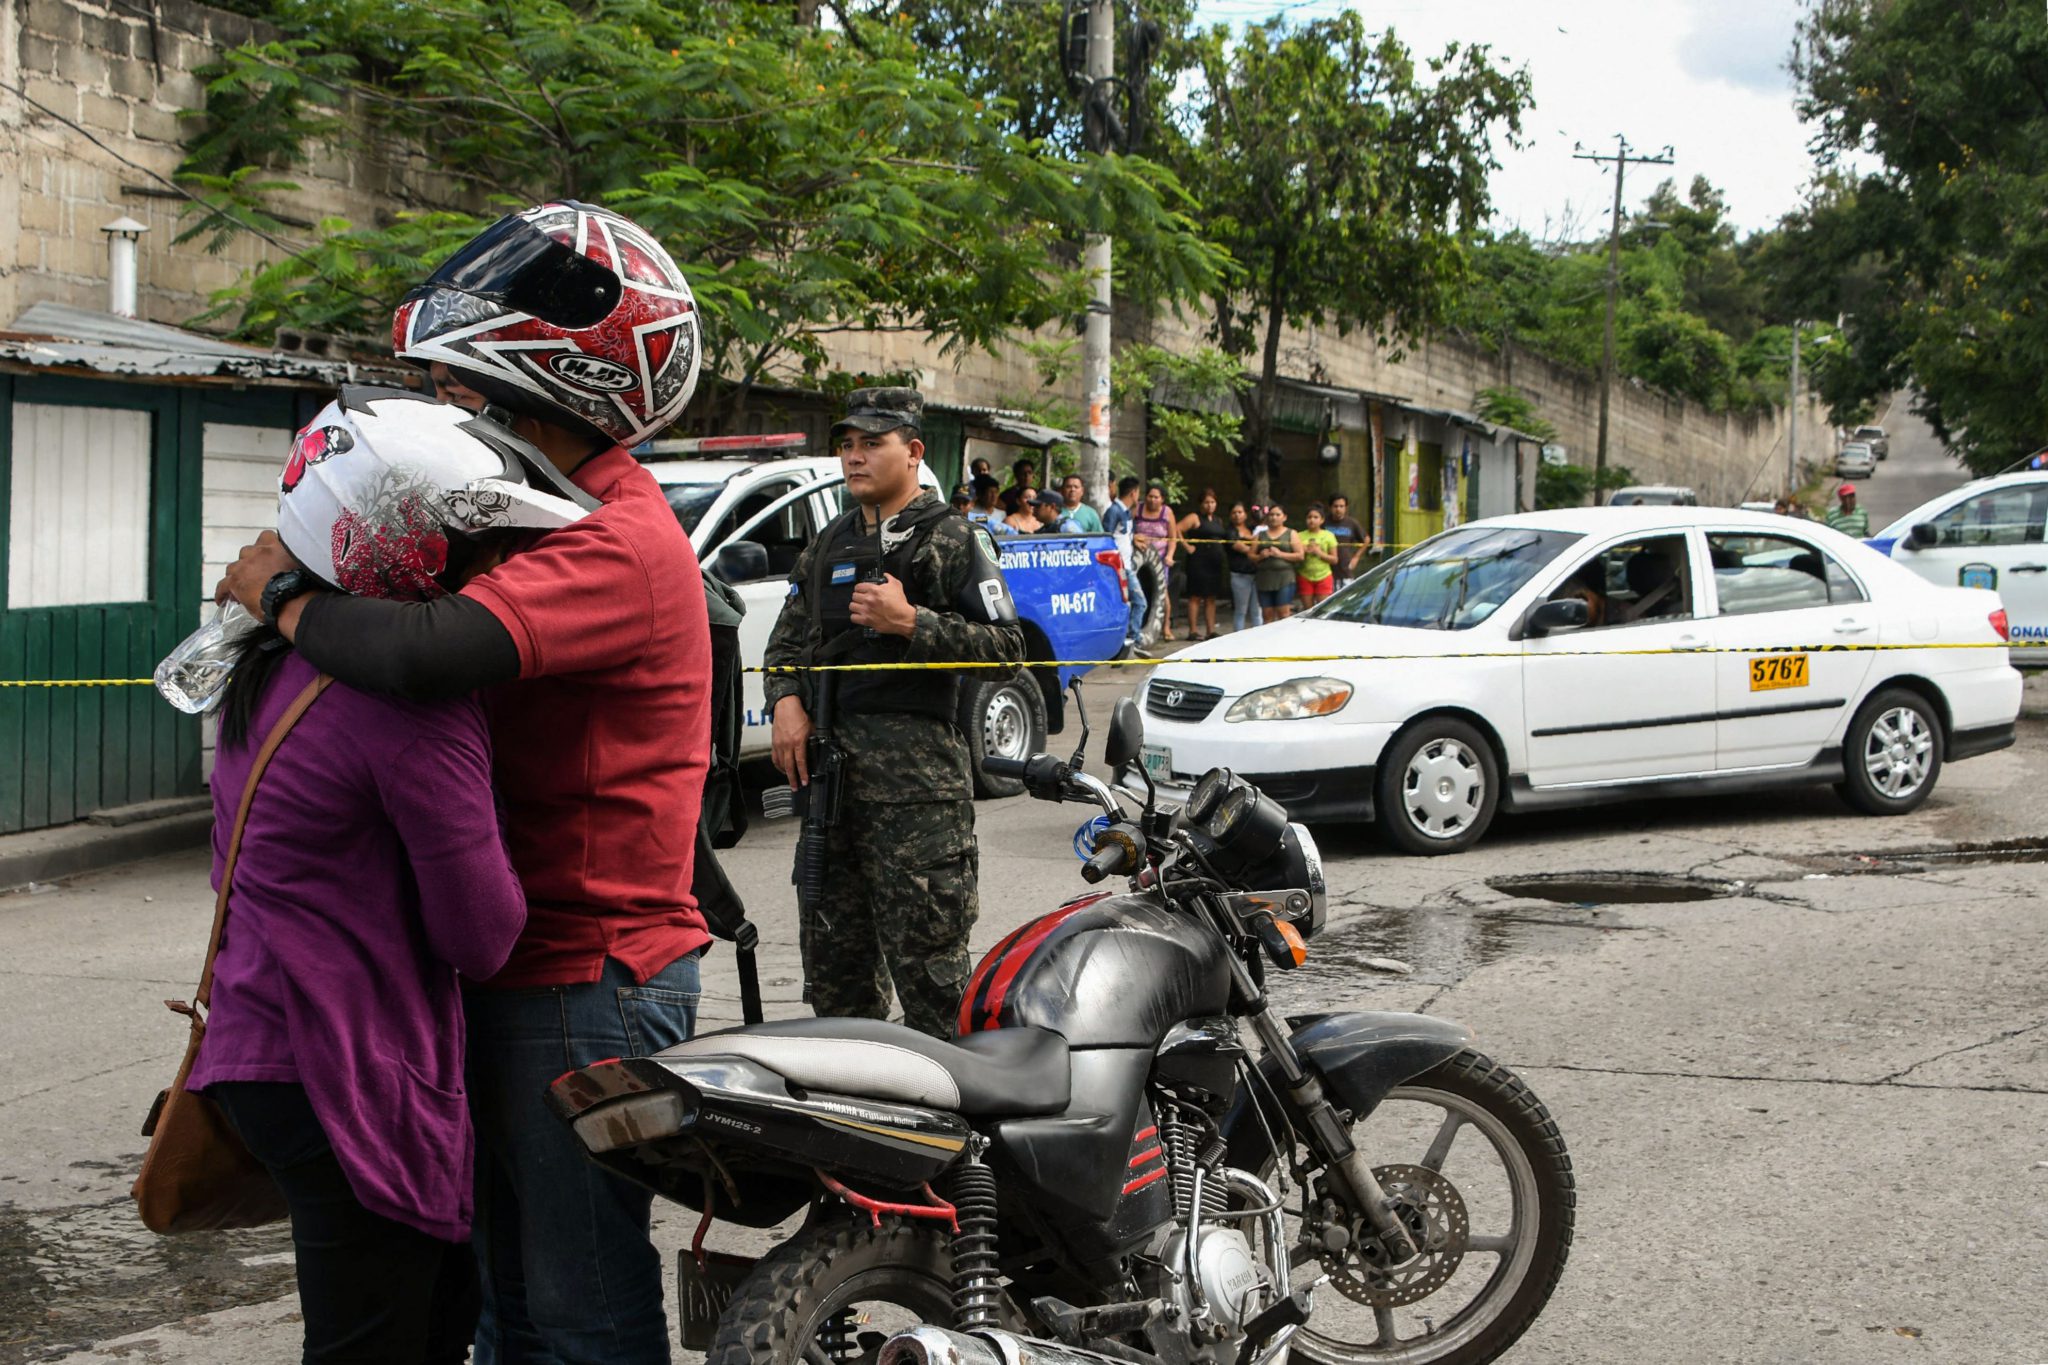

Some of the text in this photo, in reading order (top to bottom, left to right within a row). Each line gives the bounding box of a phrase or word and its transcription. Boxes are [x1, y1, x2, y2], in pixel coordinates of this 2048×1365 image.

[1031, 551, 1038, 568] Y
[1040, 549, 1092, 568] PROTEGER
[979, 578, 1004, 620] P
[1051, 591, 1095, 615] PN-617
[1753, 656, 1806, 682] 5767
[824, 1101, 917, 1129] YAMAHA Brilliant Riding
